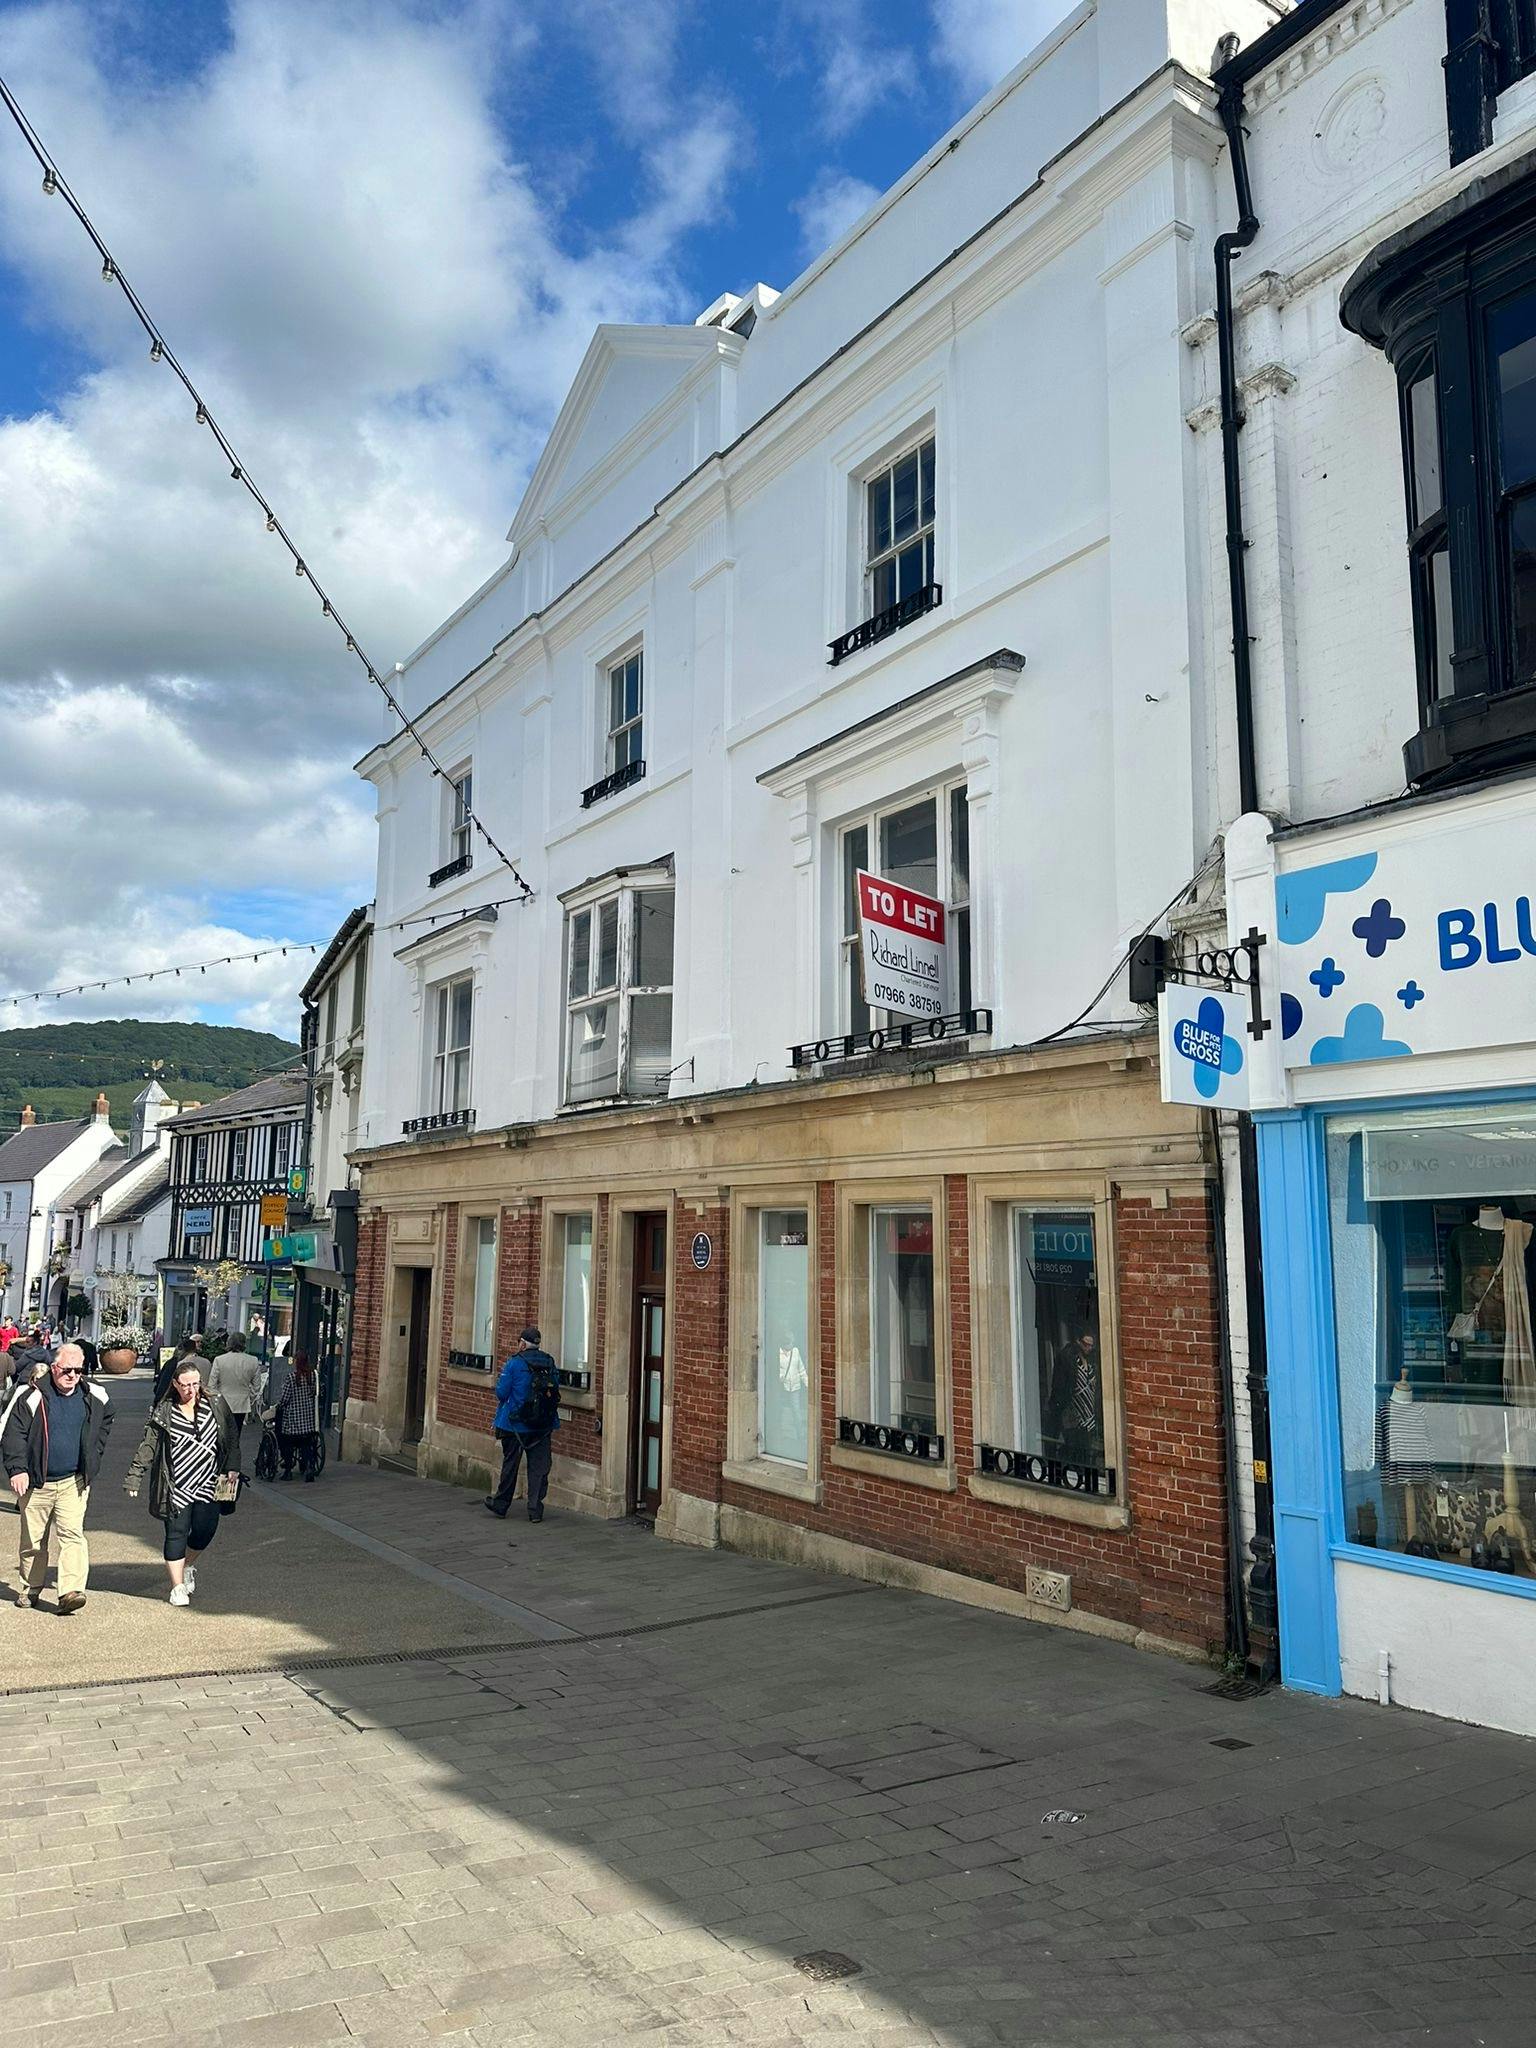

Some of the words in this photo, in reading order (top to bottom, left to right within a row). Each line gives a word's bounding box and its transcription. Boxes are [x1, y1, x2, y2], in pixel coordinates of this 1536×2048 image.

[867, 886, 895, 917] TO
[903, 899, 938, 932] LET
[870, 929, 908, 970] Richard
[910, 947, 939, 979] Linnell
[874, 983, 905, 1005] 07966
[909, 993, 942, 1015] 387519
[1182, 1022, 1210, 1046] BLUE
[1209, 1033, 1221, 1044] FOR
[1209, 1040, 1222, 1052] PETS
[1181, 1038, 1220, 1066] CROSS
